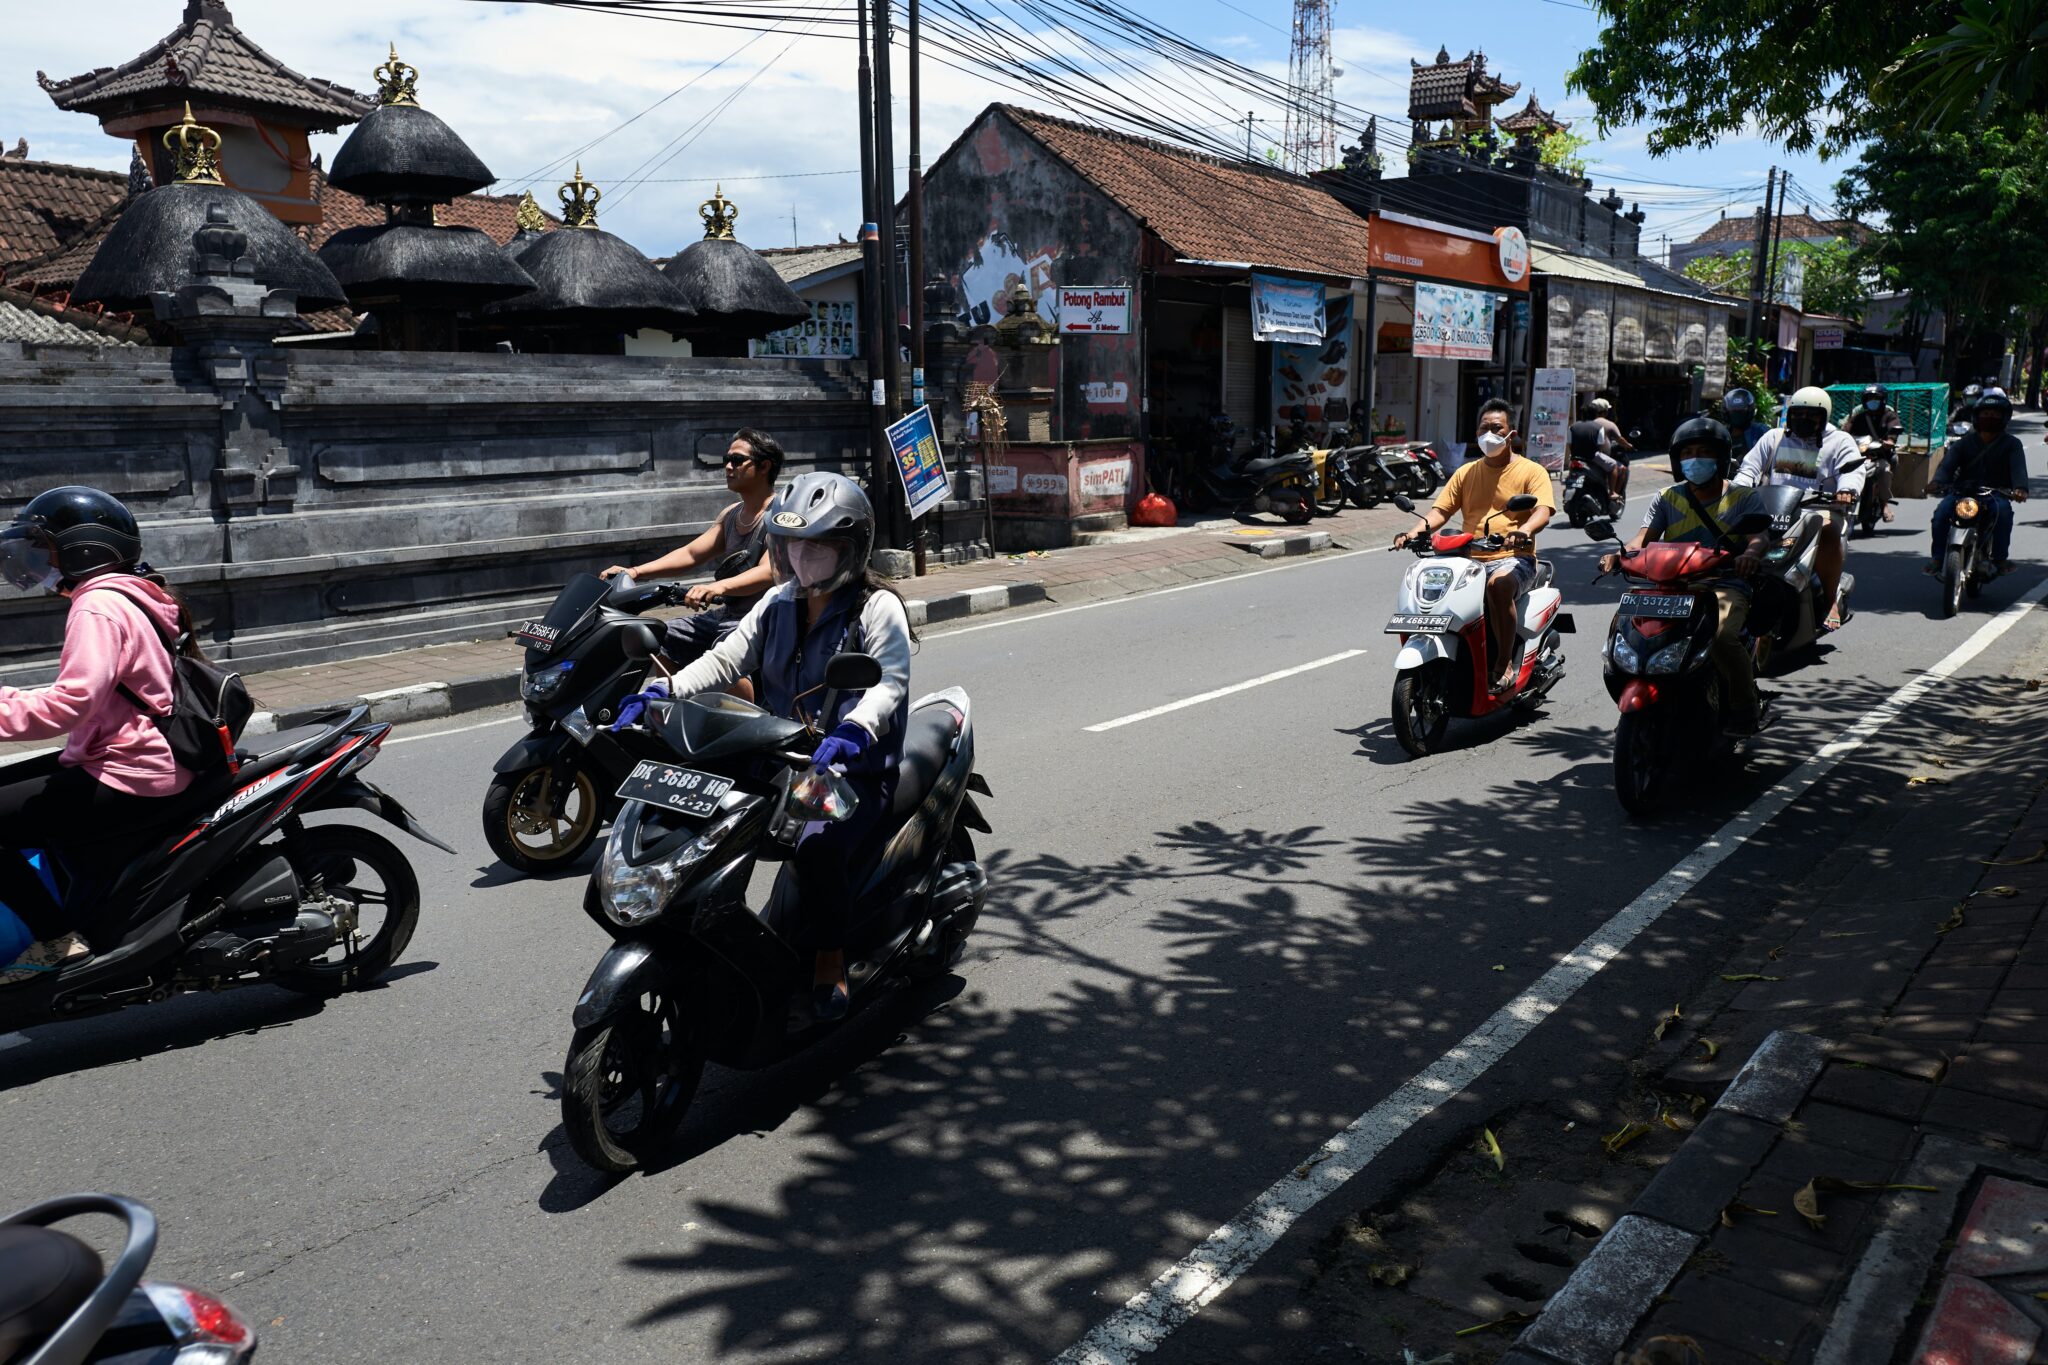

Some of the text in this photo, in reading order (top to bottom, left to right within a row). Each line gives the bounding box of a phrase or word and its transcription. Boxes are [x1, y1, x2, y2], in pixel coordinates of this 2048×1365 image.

[1063, 291, 1125, 310] Potong Rambut
[1084, 468, 1125, 487] simPATI
[1622, 595, 1636, 605] DK
[1642, 596, 1671, 607] 5372
[632, 764, 658, 780] DK
[658, 769, 702, 789] 3688
